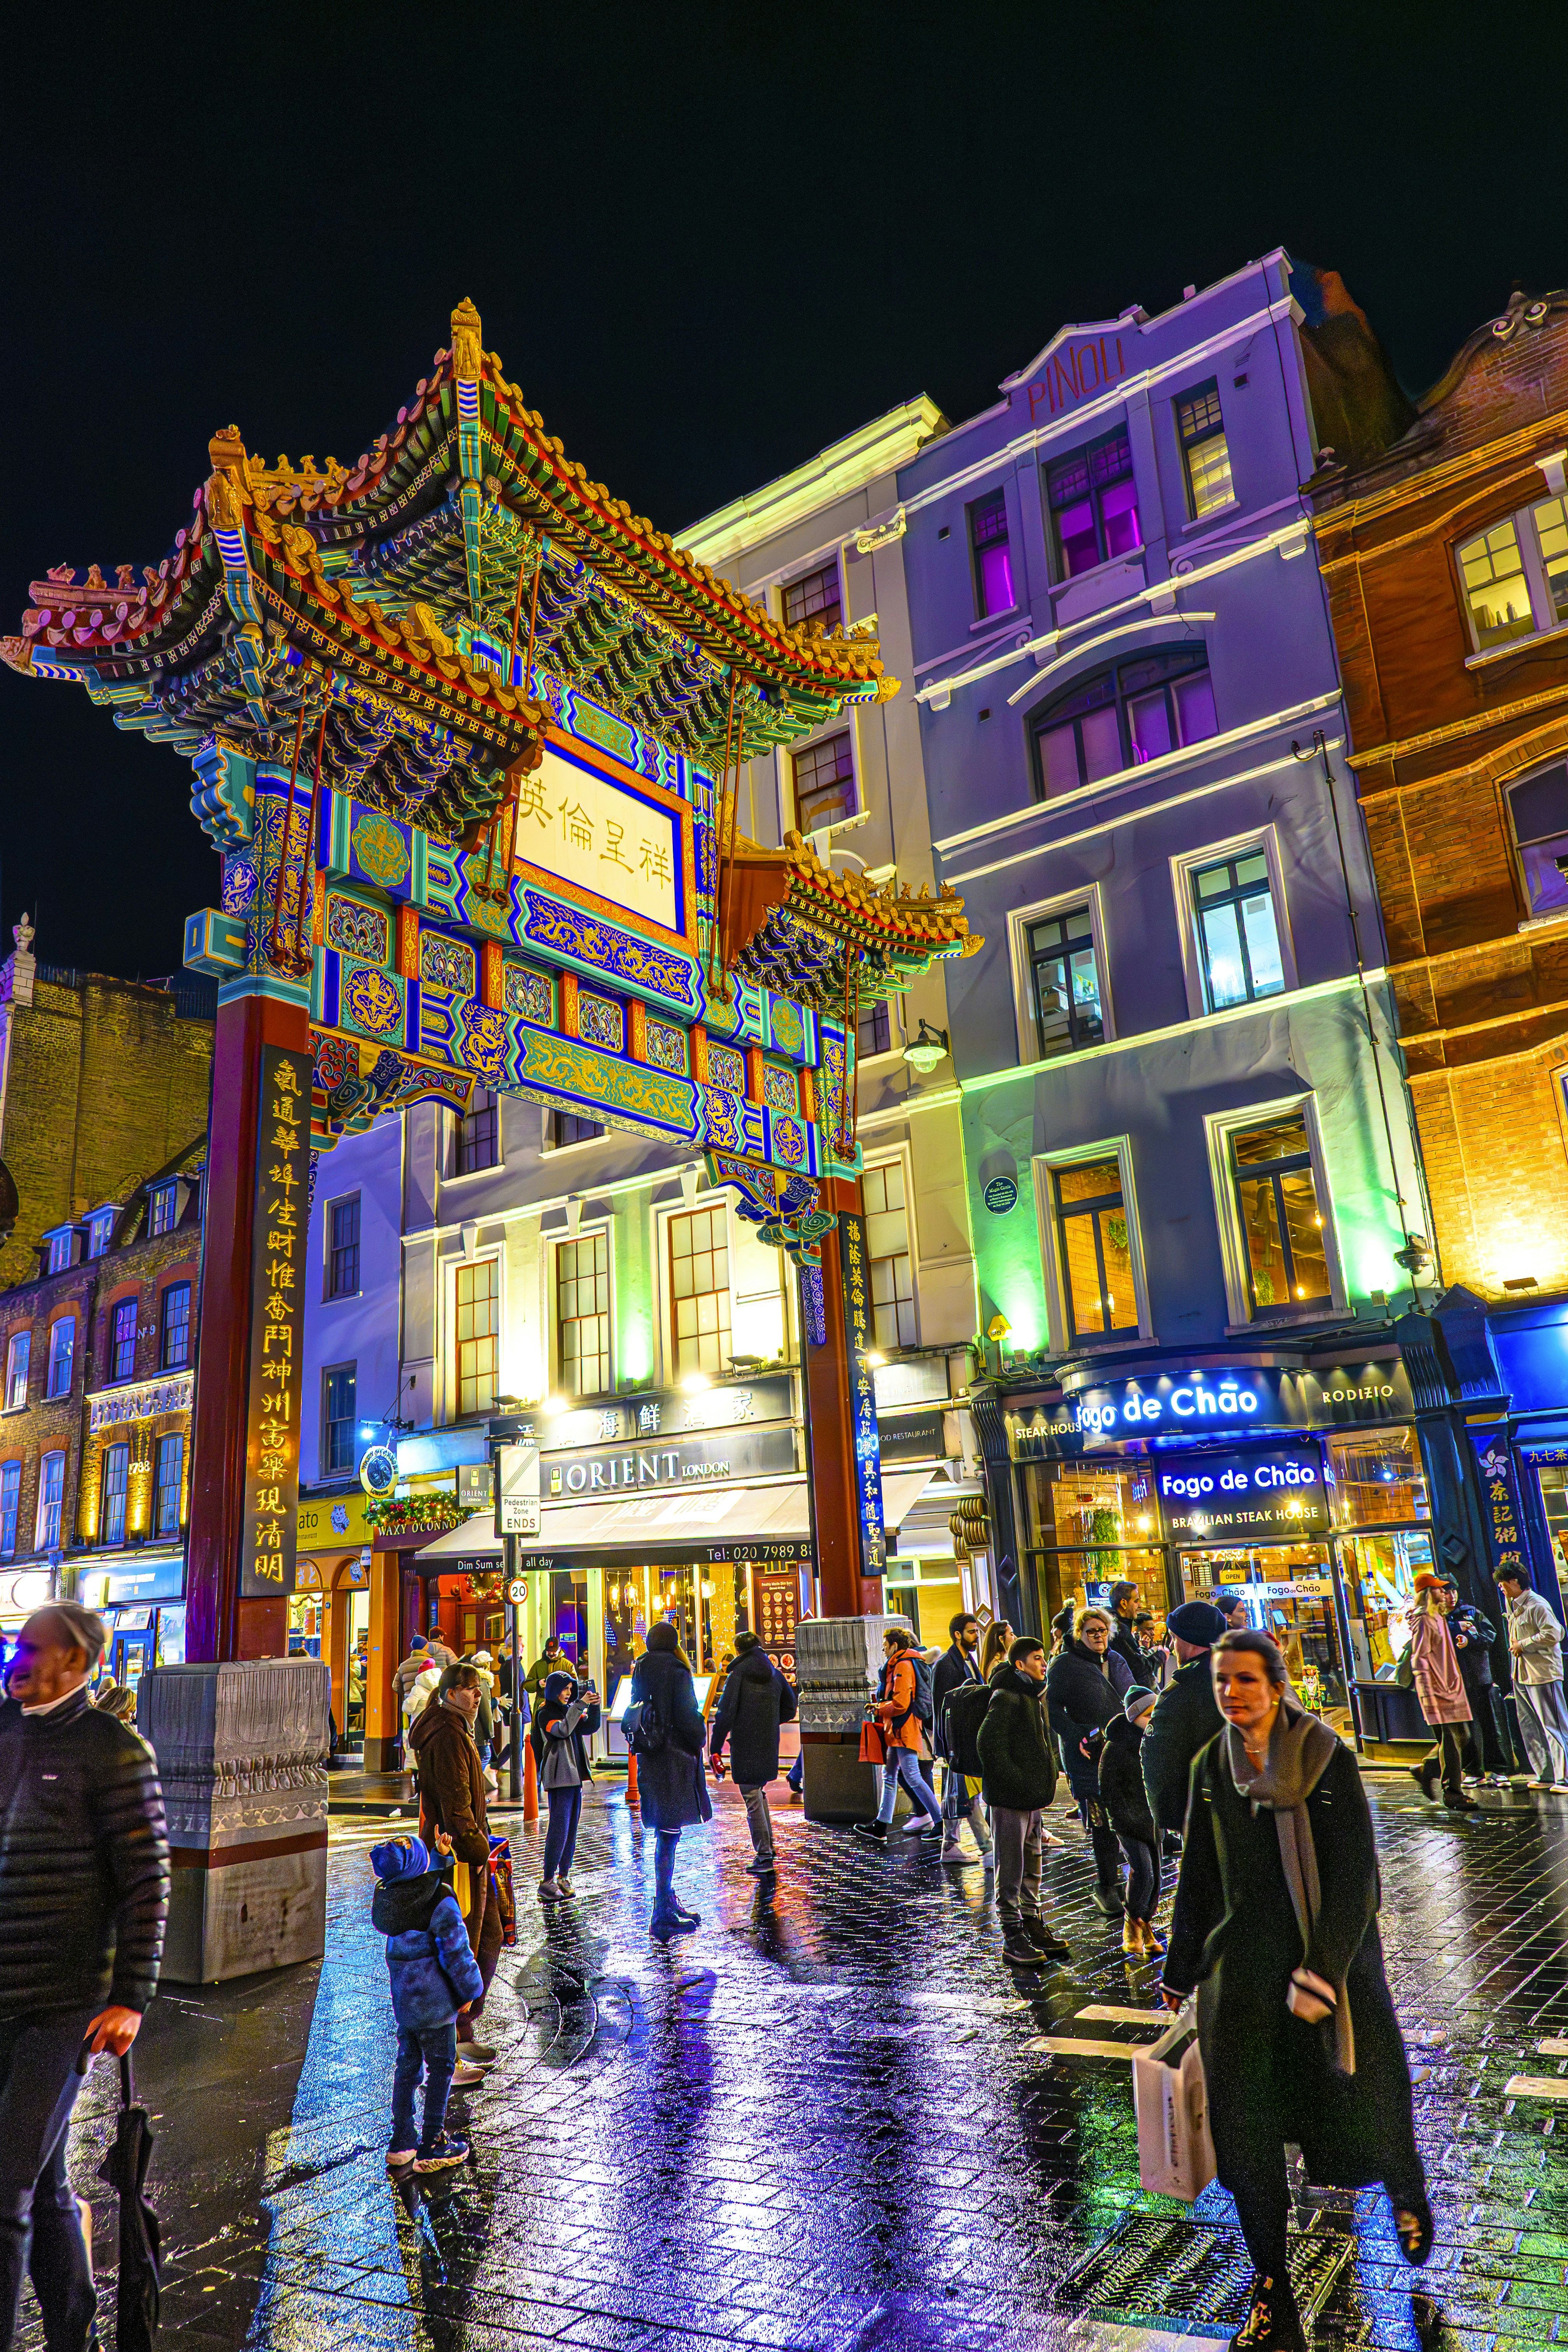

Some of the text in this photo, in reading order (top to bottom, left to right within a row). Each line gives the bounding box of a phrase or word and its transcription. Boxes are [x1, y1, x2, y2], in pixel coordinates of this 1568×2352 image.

[1027, 337, 1125, 422] PINOLI
[519, 775, 672, 890] 英倫呈祥
[149, 1325, 156, 1335] 9
[166, 1384, 190, 1398] AND
[1322, 1385, 1393, 1404] RODIZIO
[1077, 1383, 1258, 1434] Fogo de Chão
[893, 1429, 936, 1440] RESTAURANT
[1015, 1422, 1080, 1439] STEAK HOUS
[1530, 1449, 1568, 1462] 九七茶
[567, 1452, 679, 1490] ORIENT
[681, 1460, 730, 1477] LONDON
[1162, 1475, 1213, 1498] Fogo
[1220, 1468, 1248, 1490] de
[1255, 1461, 1315, 1488] Chão
[508, 1519, 535, 1528] ENDS
[1172, 1506, 1319, 1528] BRAZILIAN STEAK HOUSE
[378, 1518, 467, 1536] WAXY O'CONNOR'
[707, 1544, 812, 1560] Tel: 020 7989 8
[458, 1561, 473, 1570] Dim
[476, 1560, 493, 1569] Sum
[526, 1557, 536, 1567] all
[539, 1556, 553, 1568] day
[512, 1586, 525, 1597] 20
[1195, 1590, 1216, 1599] Fogo
[1222, 1587, 1245, 1596] Chão
[1267, 1586, 1289, 1595] Fogo
[1296, 1584, 1320, 1593] Chão
